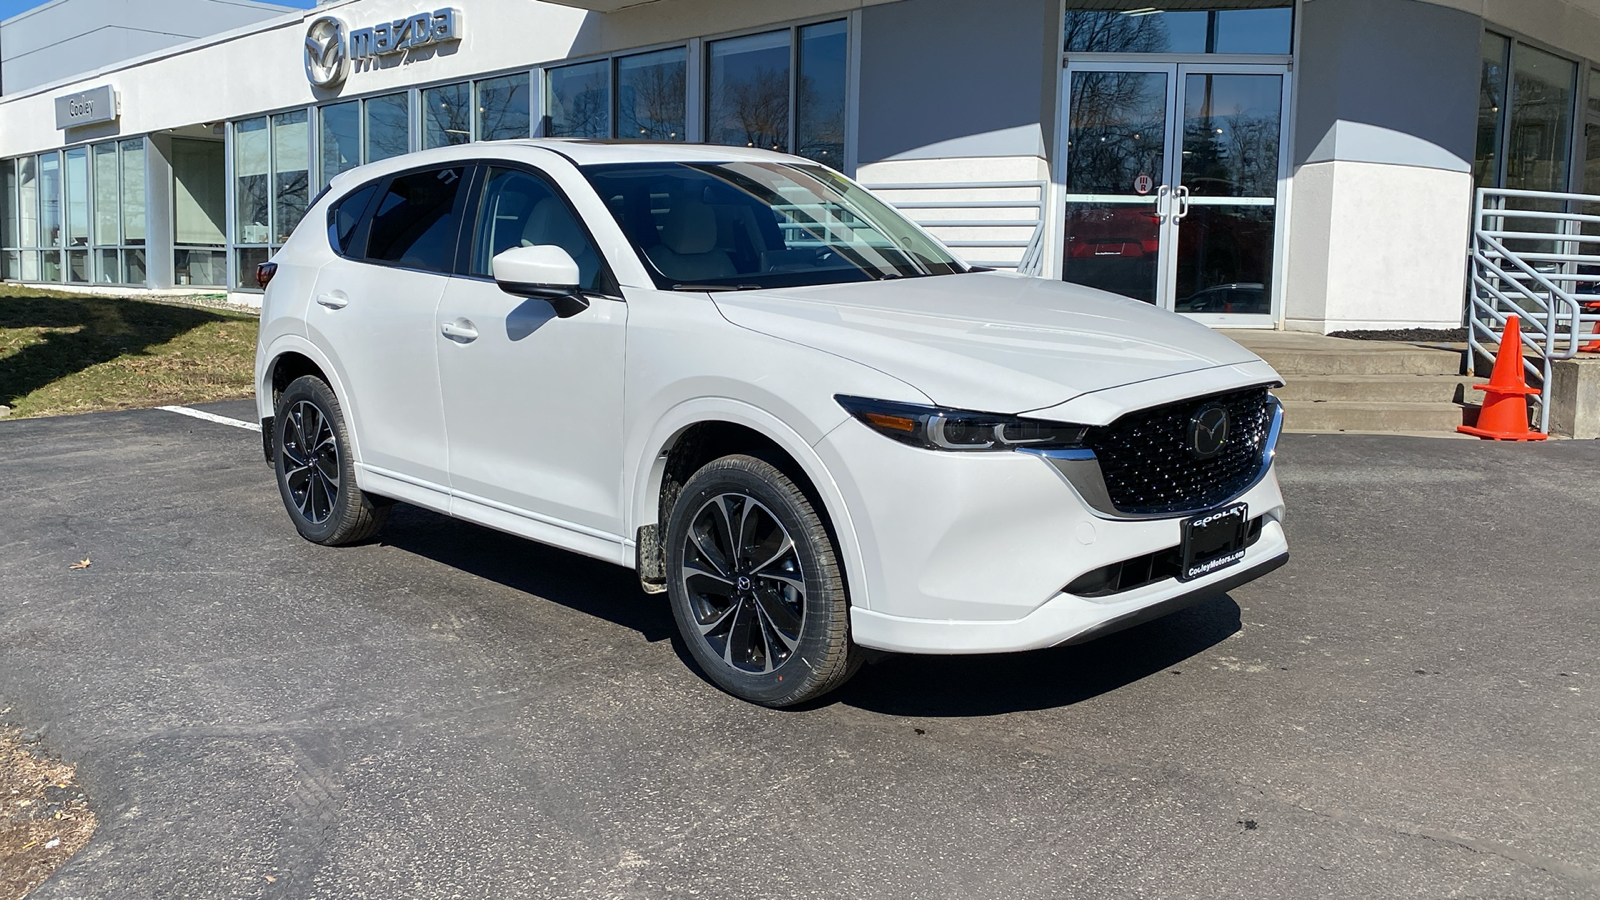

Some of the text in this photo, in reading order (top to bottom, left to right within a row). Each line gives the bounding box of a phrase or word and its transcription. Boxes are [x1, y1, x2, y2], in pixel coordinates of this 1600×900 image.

[69, 95, 94, 117] Cooley
[1193, 504, 1246, 527] COOLEY
[1188, 551, 1244, 576] CooleyMotors.com
